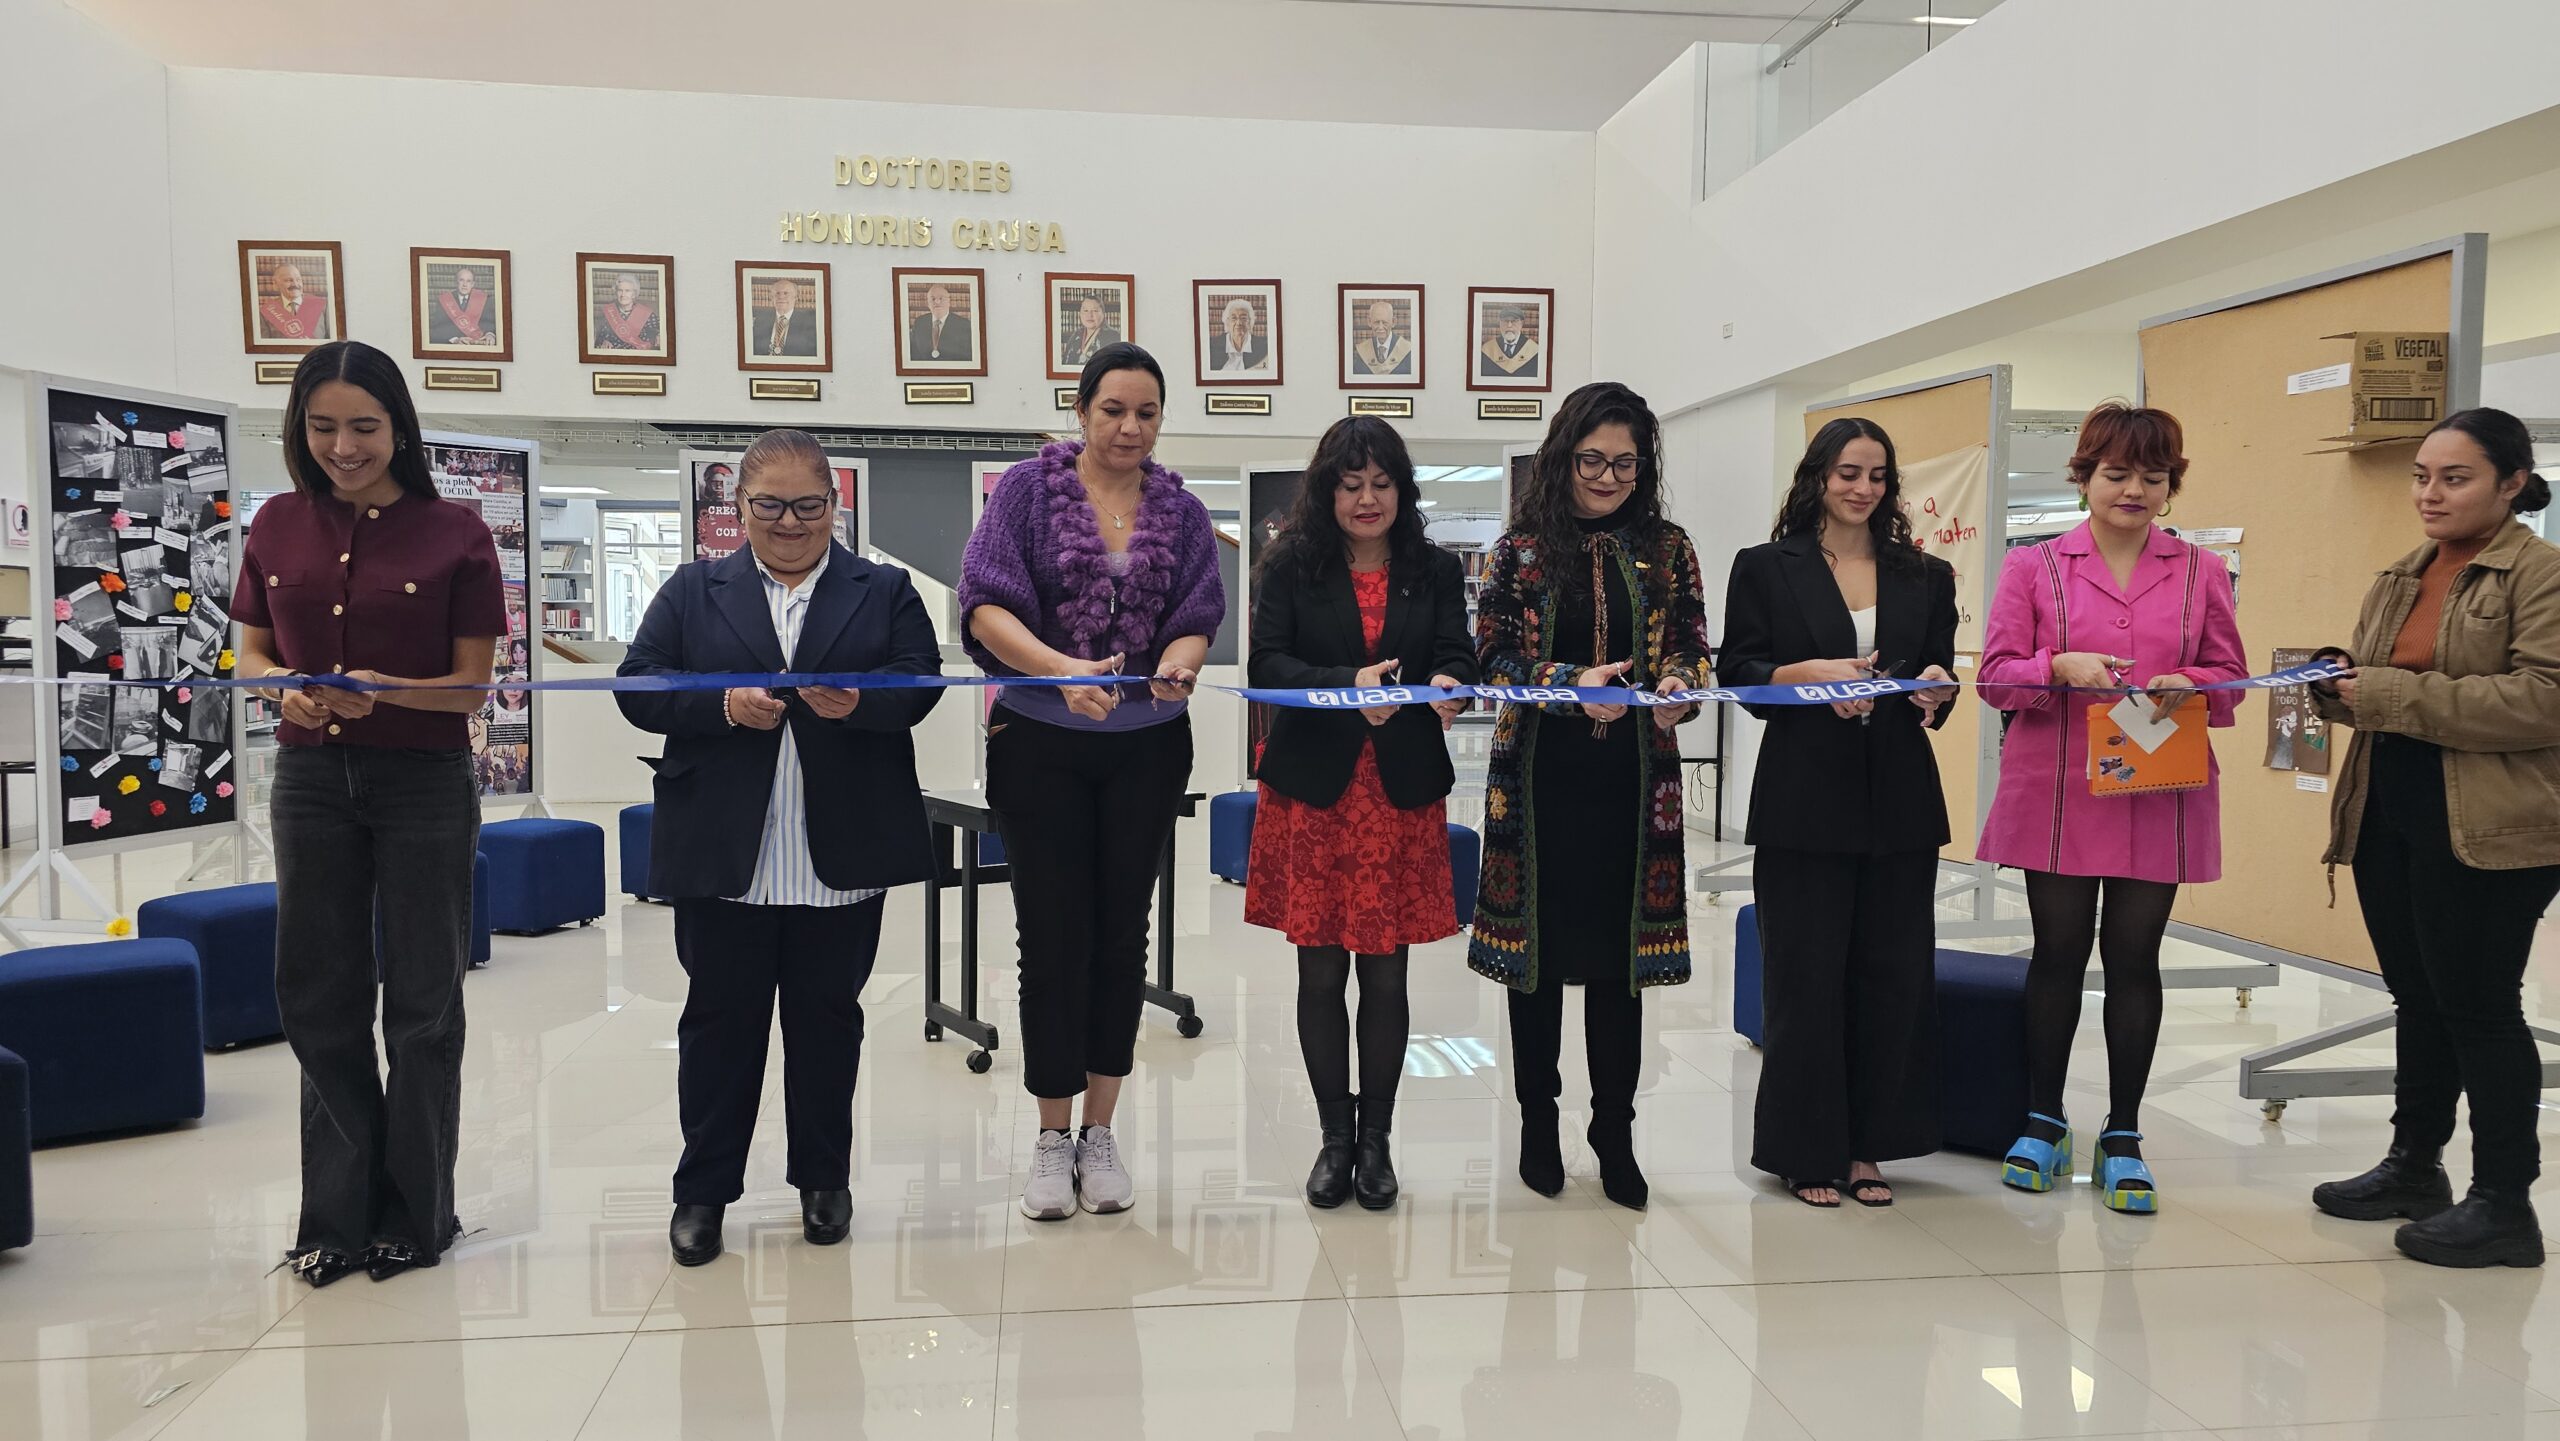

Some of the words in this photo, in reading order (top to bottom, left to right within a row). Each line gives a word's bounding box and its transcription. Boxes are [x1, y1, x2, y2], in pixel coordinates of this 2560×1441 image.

[834, 155, 1012, 193] DOCTORES
[780, 210, 933, 248] HONORIS
[952, 217, 1066, 253] CAUSA
[2364, 345, 2384, 353] VALLEY
[2394, 339, 2443, 357] VEGETAL
[444, 487, 472, 496] OCDM
[708, 506, 737, 515] CREC
[1923, 496, 1941, 518] a
[716, 528, 737, 537] CON
[1932, 517, 1977, 545] maten
[708, 549, 737, 558] MIE
[2289, 685, 2299, 695] DE
[2275, 696, 2298, 705] TODO
